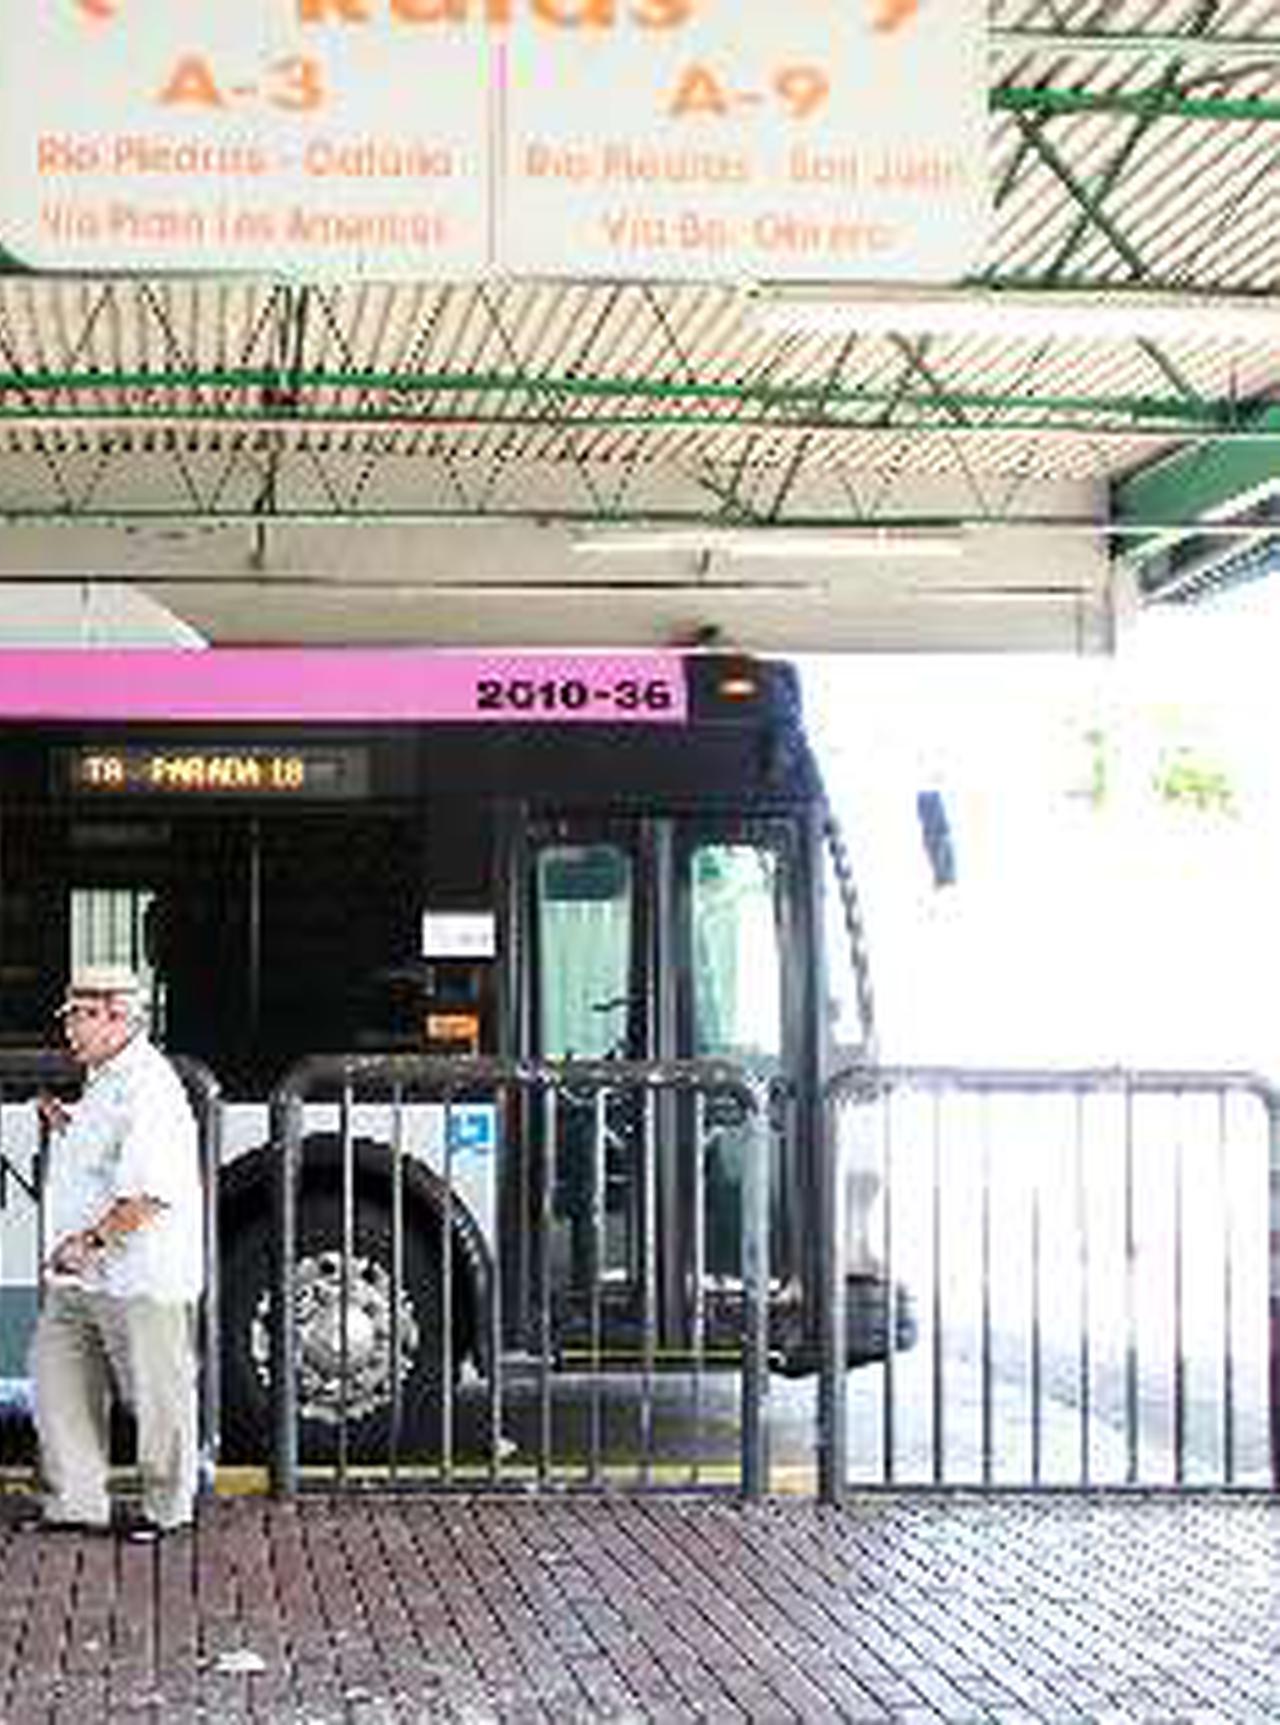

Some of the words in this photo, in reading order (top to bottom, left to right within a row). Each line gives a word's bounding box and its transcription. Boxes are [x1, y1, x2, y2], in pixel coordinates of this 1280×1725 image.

[158, 55, 324, 110] A-3
[668, 64, 829, 116] A-9
[477, 681, 670, 709] 2010-36
